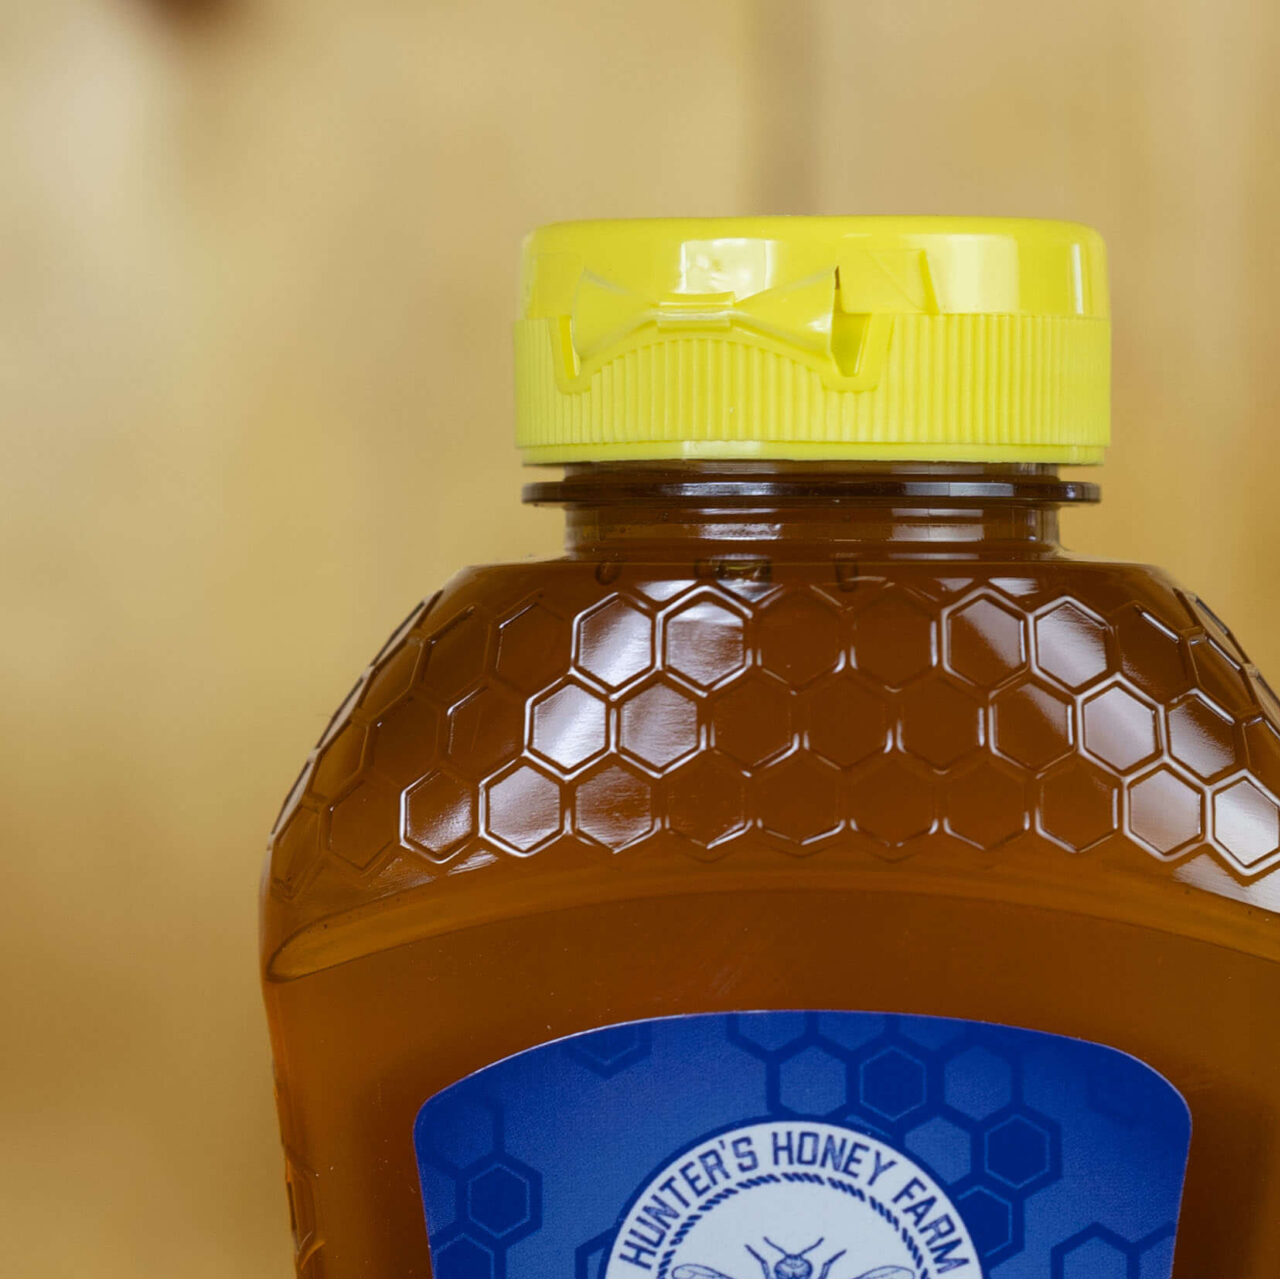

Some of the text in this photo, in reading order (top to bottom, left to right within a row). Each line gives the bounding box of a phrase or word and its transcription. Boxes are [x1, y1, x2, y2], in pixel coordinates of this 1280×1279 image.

[618, 1131, 970, 1274] HUNTER'S HONEY FARM
